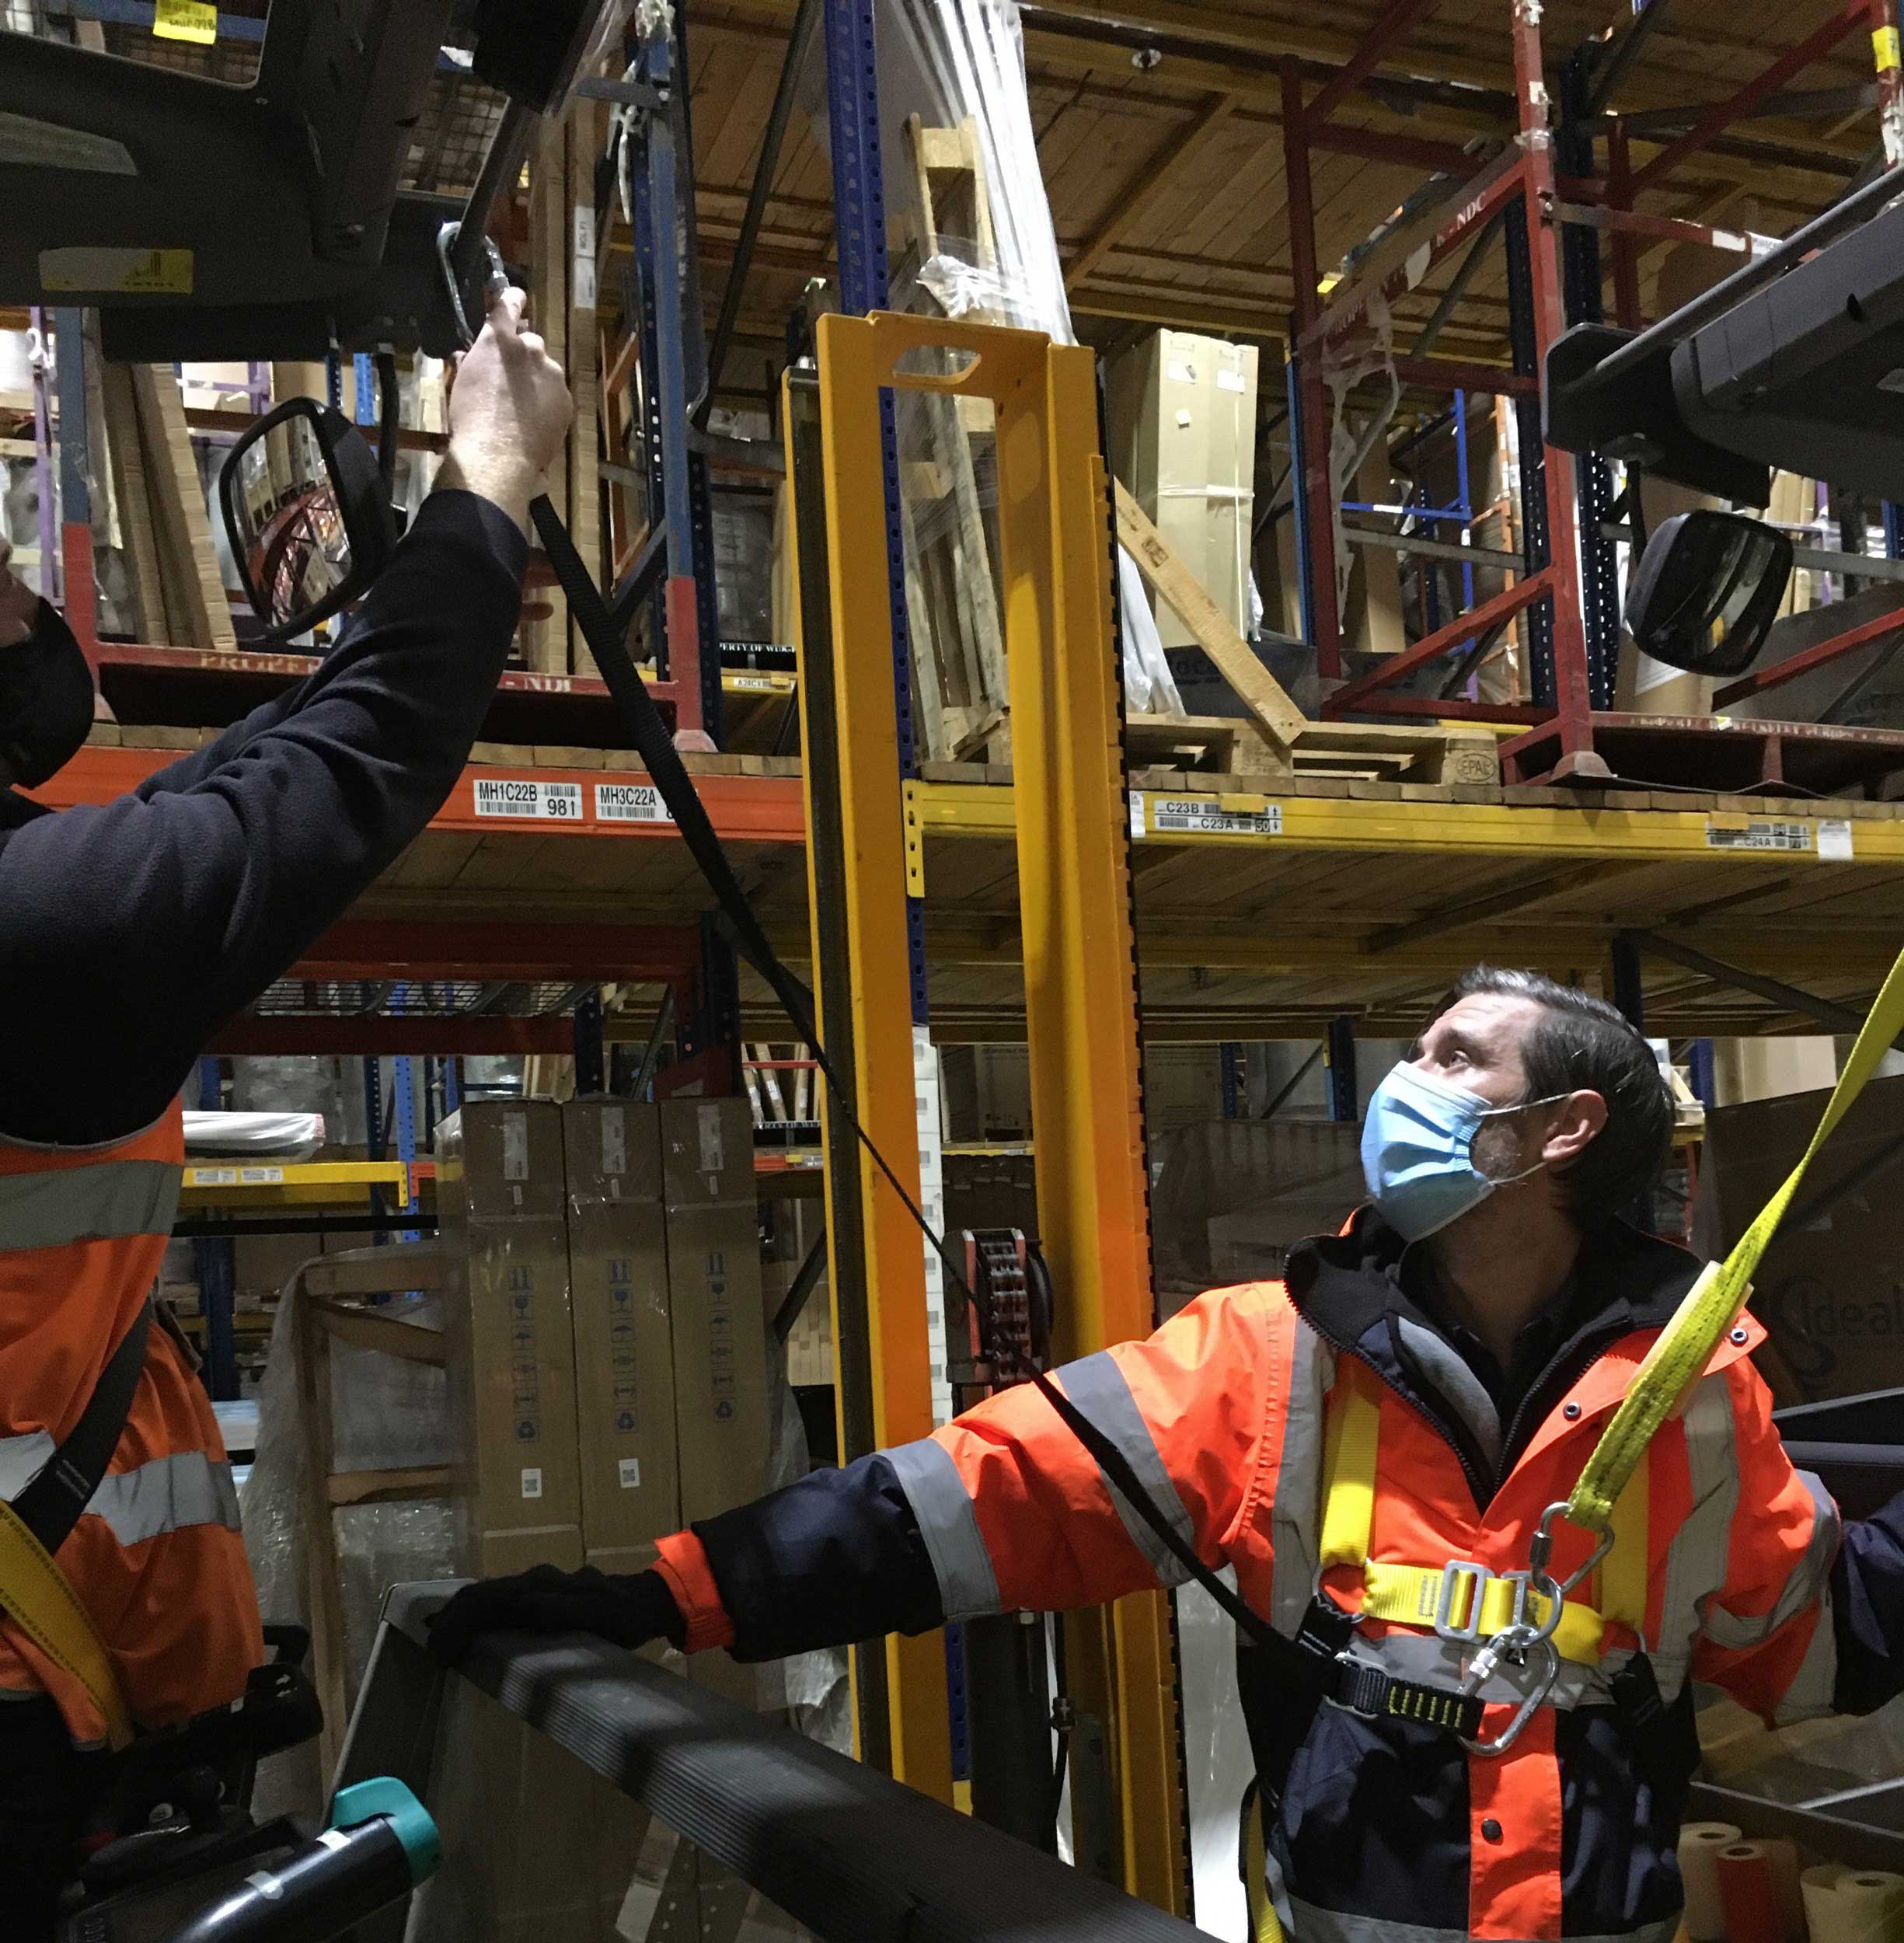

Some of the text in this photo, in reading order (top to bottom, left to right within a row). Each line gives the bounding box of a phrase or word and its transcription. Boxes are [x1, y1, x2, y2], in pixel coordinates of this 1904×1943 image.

[1456, 191, 1486, 231] NDC
[750, 644, 762, 652] OF
[1462, 759, 1491, 776] EPAL
[479, 782, 538, 801] MH1C22B
[600, 787, 657, 806] MH3C22A
[546, 798, 576, 817] 981
[1166, 801, 1200, 815] C23B
[1201, 818, 1234, 830] C23A
[1744, 837, 1771, 847] C24A
